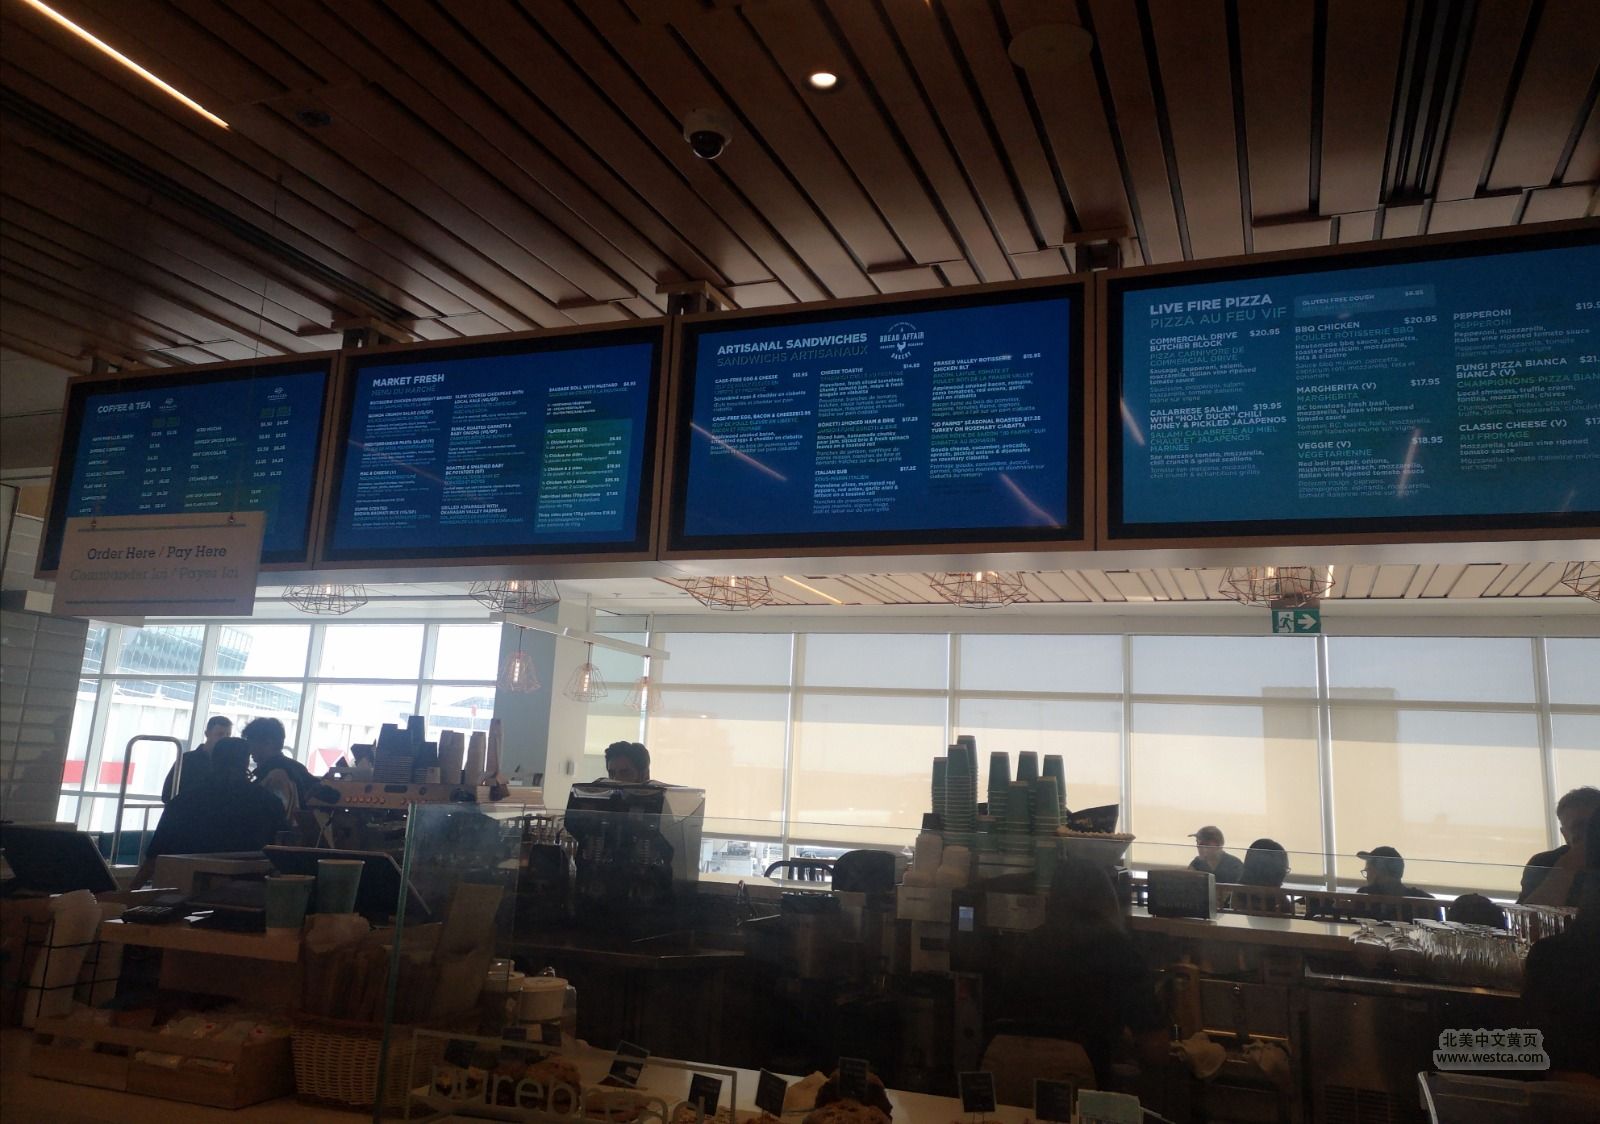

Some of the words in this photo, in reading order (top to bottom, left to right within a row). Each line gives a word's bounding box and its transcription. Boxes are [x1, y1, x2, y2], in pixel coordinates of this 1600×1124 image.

[1150, 304, 1184, 315] LIVE
[1187, 299, 1222, 312] FIRE
[1226, 294, 1272, 308] PIZZA
[1151, 315, 1194, 328] PIZZA
[1200, 312, 1220, 324] AU
[1226, 309, 1256, 322] FEU
[1261, 306, 1287, 320] VIF
[1454, 308, 1512, 320] PEPPERONI
[1295, 325, 1315, 334] BBQ
[1318, 322, 1360, 332] CHICKEN
[1404, 315, 1438, 324] $20.95
[1150, 334, 1208, 345] COMMERCIAL
[1210, 332, 1238, 340] DRIVE
[1250, 328, 1280, 337] $20.95
[1296, 332, 1332, 342] POULET
[1393, 326, 1414, 334] BBQ
[717, 341, 782, 356] ARTISANAL
[786, 332, 868, 349] SANDWICHES
[1150, 343, 1190, 352] BUTCHER
[1192, 340, 1222, 348] BLOCK
[1150, 352, 1175, 360] PIZZA
[1456, 363, 1488, 372] FUNGI
[1491, 360, 1522, 370] PIZZA
[1526, 358, 1568, 367] BIANCA
[1456, 370, 1497, 379] BIANCA
[1500, 369, 1516, 377] (V)
[372, 376, 412, 388] MARKET
[414, 373, 445, 384] FRESH
[1297, 384, 1359, 394] MARGHERITA
[1362, 382, 1376, 390] (V)
[1410, 378, 1440, 387] $17.95
[1456, 378, 1536, 388] CHAMPIGNONS
[1297, 393, 1359, 402] MARGHERITA
[98, 404, 128, 413] COFFEE
[128, 402, 134, 411] &
[136, 401, 151, 410] TEA
[1150, 407, 1202, 416] CALABRESE
[1204, 405, 1238, 414] SALAMI
[1253, 402, 1282, 410] $19.95
[1150, 415, 1174, 423] WITH
[1176, 413, 1203, 422] "HOLY
[1206, 412, 1236, 420] DUCK"
[1150, 422, 1180, 431] HONEY
[1192, 419, 1230, 428] PICKLED
[1232, 416, 1287, 426] JALAPENOS
[1240, 426, 1254, 434] AU
[1460, 422, 1504, 432] CLASSIC
[1506, 420, 1548, 430] CHEESE
[1550, 418, 1568, 428] (V)
[1478, 430, 1530, 440] FROMAGE
[1298, 442, 1334, 450] VEGGIE
[1337, 440, 1352, 448] (V)
[1412, 436, 1444, 444] $18.95
[88, 548, 124, 560] Order
[126, 547, 156, 559] Here
[166, 546, 192, 560] Pay
[194, 545, 227, 558] Here
